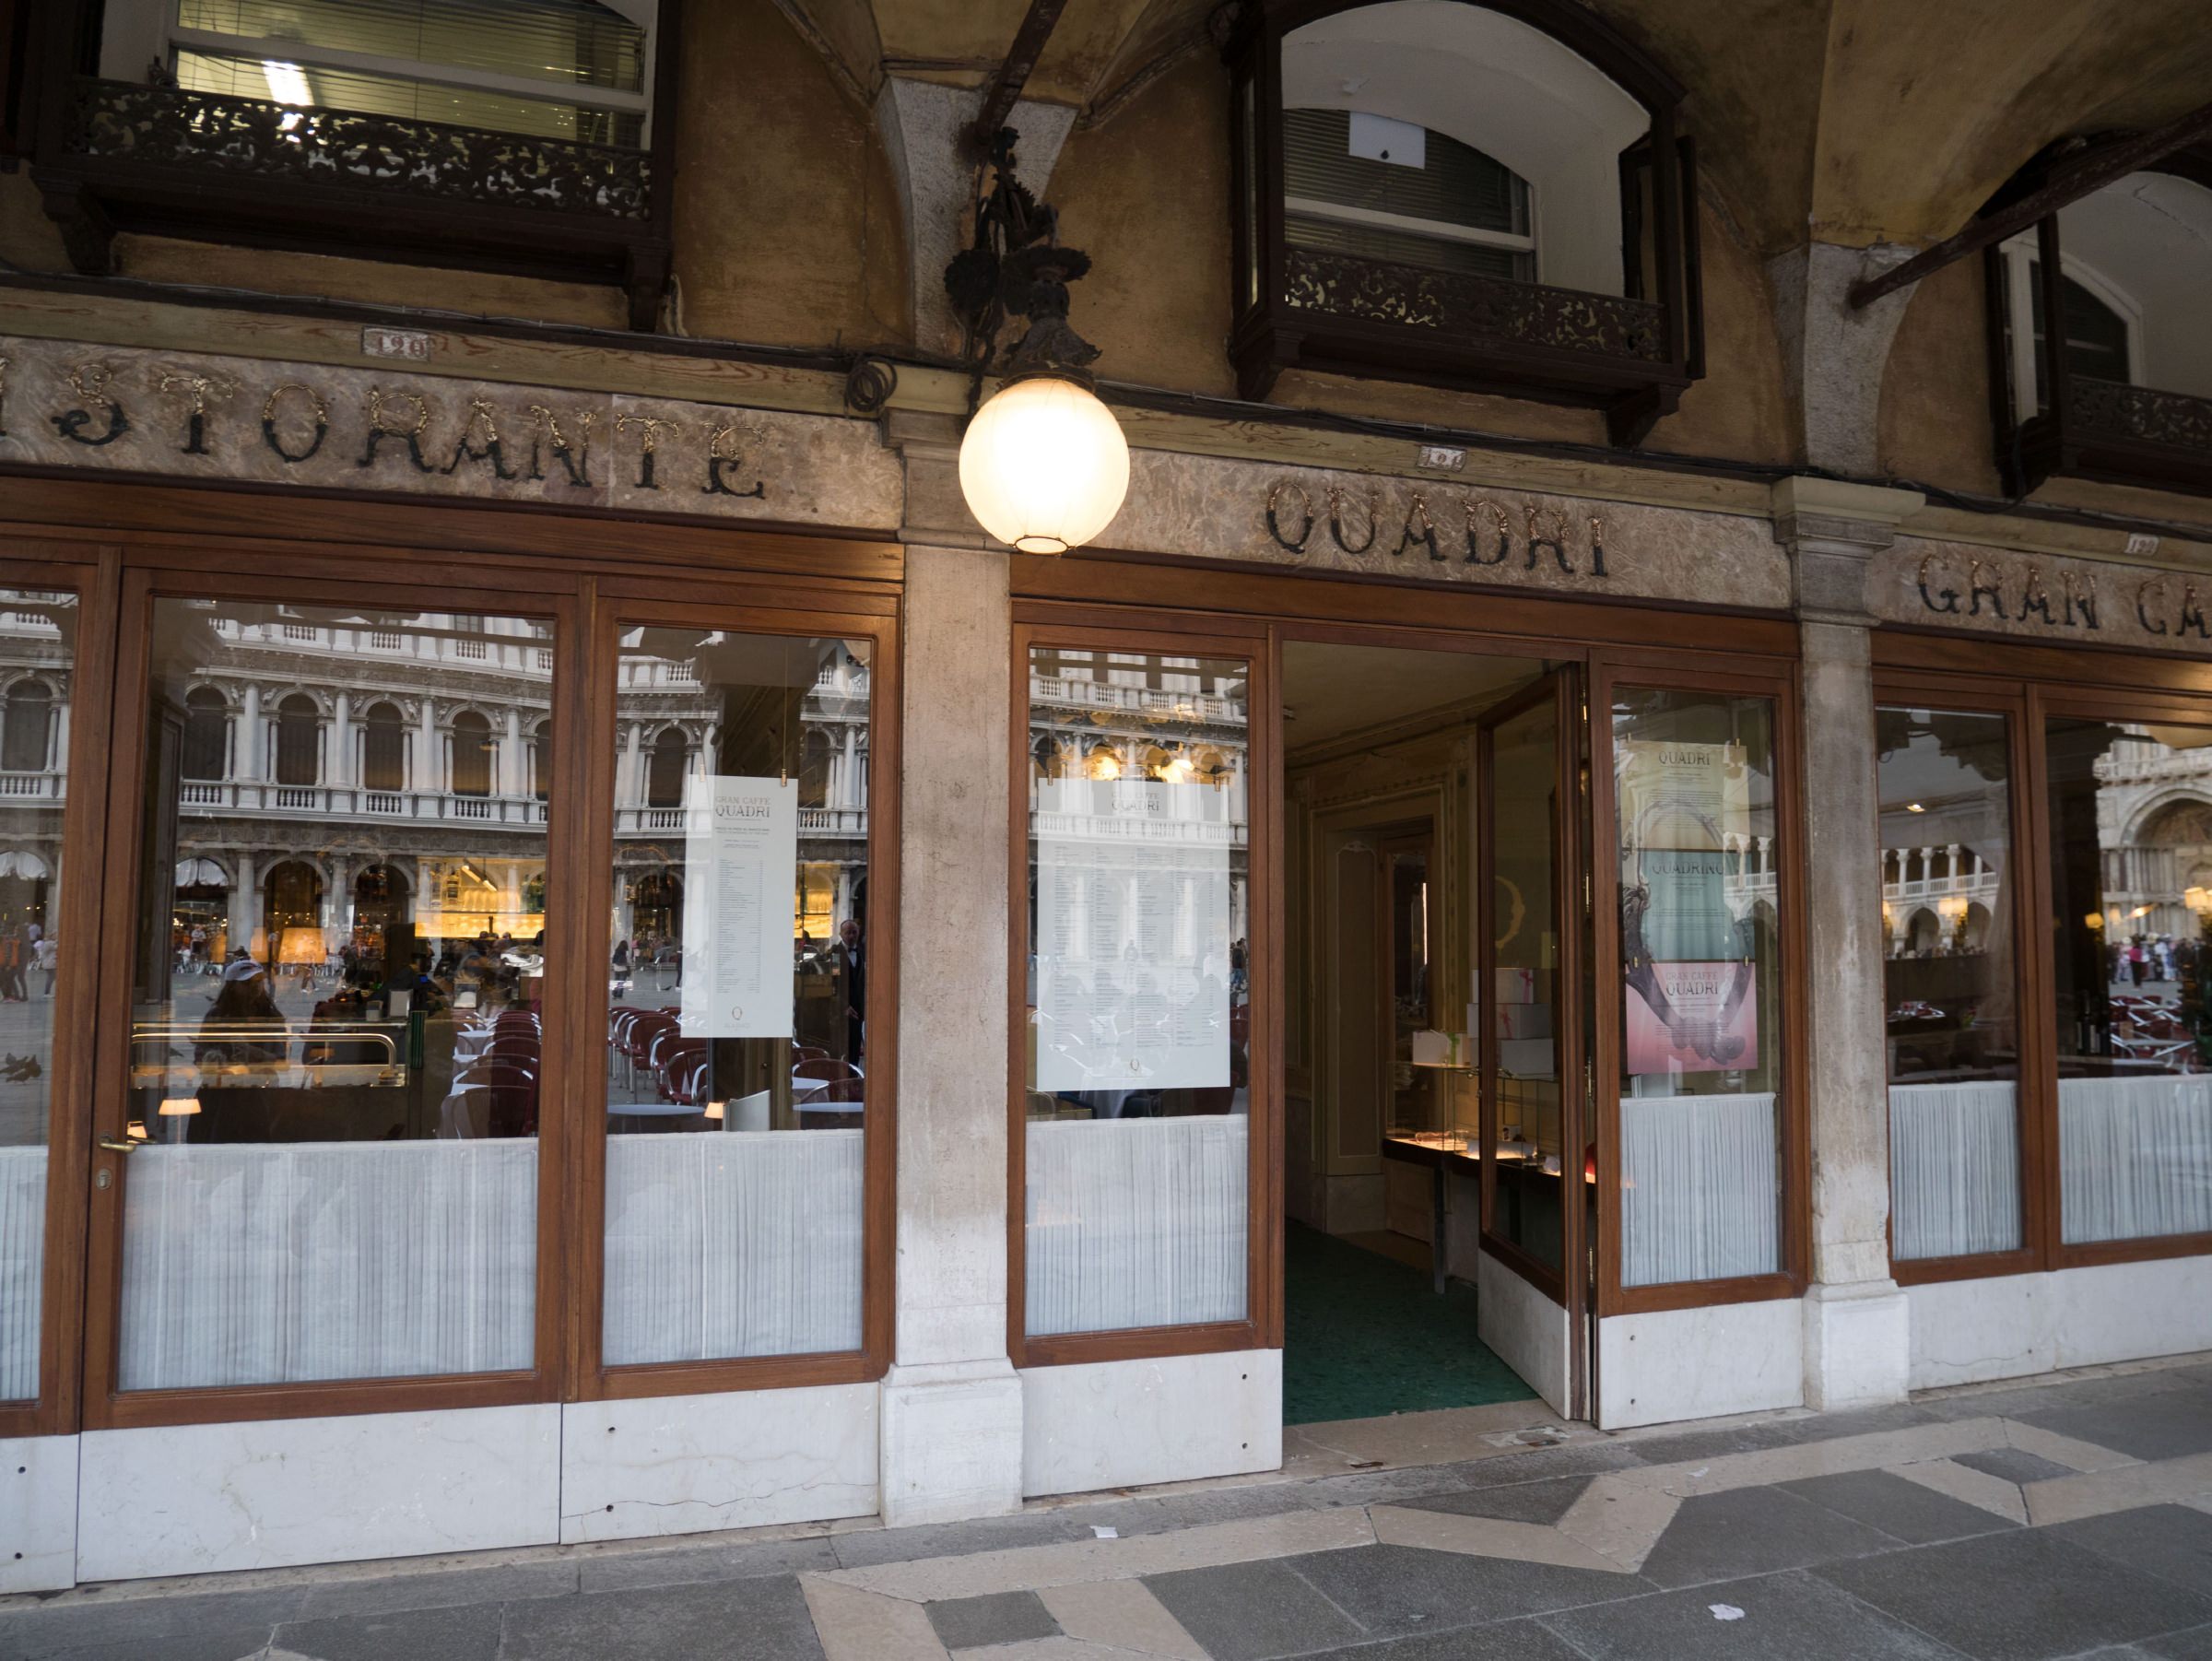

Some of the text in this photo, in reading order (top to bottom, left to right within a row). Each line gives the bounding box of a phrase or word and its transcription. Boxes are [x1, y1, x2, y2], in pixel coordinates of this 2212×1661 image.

[0, 357, 767, 501] STORANTE
[1265, 483, 1608, 577] QUADRI
[1918, 554, 2100, 630] GRAN
[1659, 750, 1711, 765] QUADRI
[715, 805, 771, 818] QUADRI
[1665, 982, 1719, 995] QUADRI
